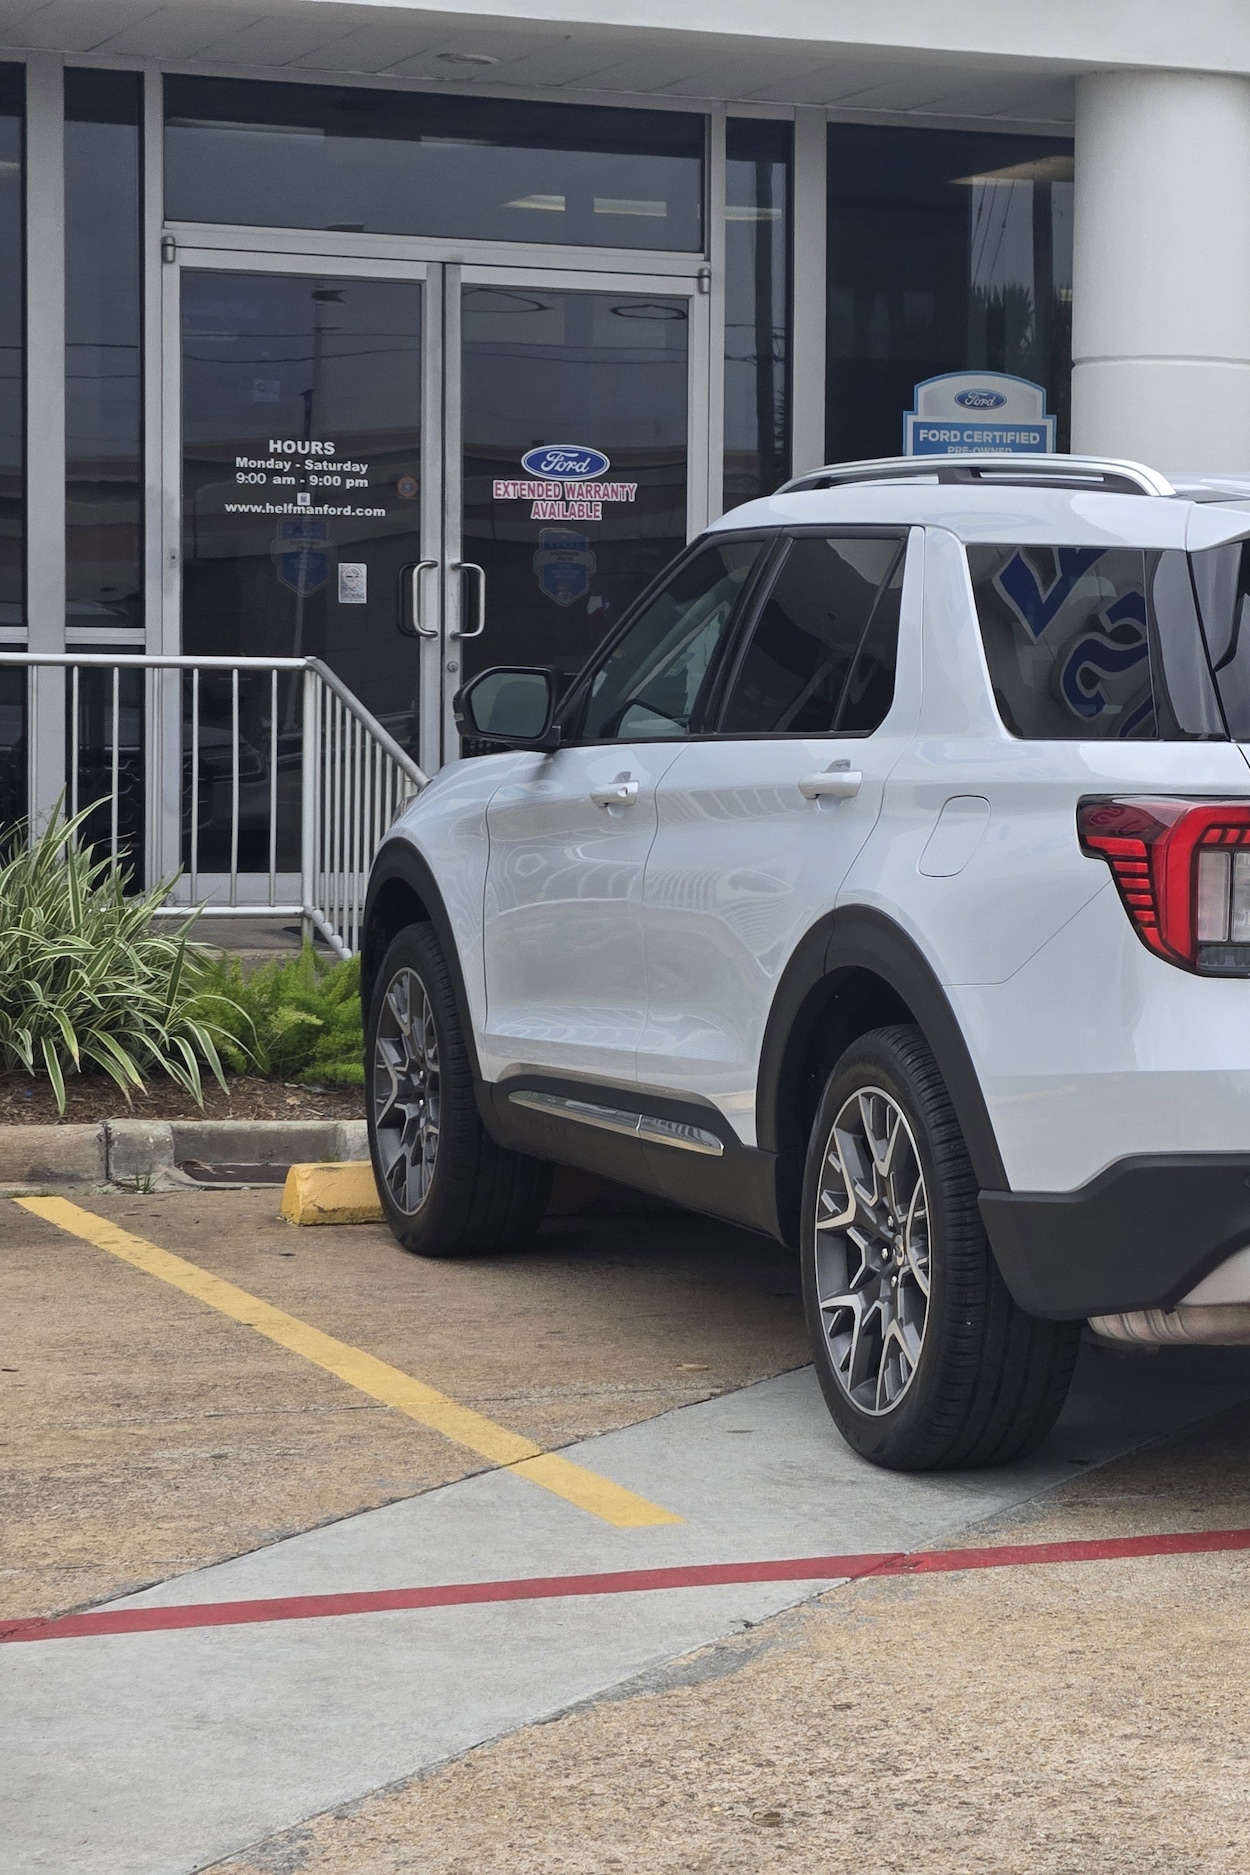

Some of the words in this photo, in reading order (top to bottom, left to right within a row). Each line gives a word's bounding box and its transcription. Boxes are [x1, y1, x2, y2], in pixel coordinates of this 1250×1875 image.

[919, 429, 961, 442] FORD
[963, 430, 1040, 444] CERTIFIED
[268, 439, 336, 455] HOURS
[235, 457, 292, 472] Monday
[304, 459, 368, 474] Saturday
[235, 472, 267, 485] 9:00
[272, 476, 296, 485] am
[309, 475, 341, 487] 9:00
[345, 479, 369, 489] pm
[493, 480, 562, 500] EXTENDED
[564, 482, 637, 502] WARRANTY
[224, 503, 386, 517] www.helfmanford.com
[530, 501, 602, 520] AVAILABLE
